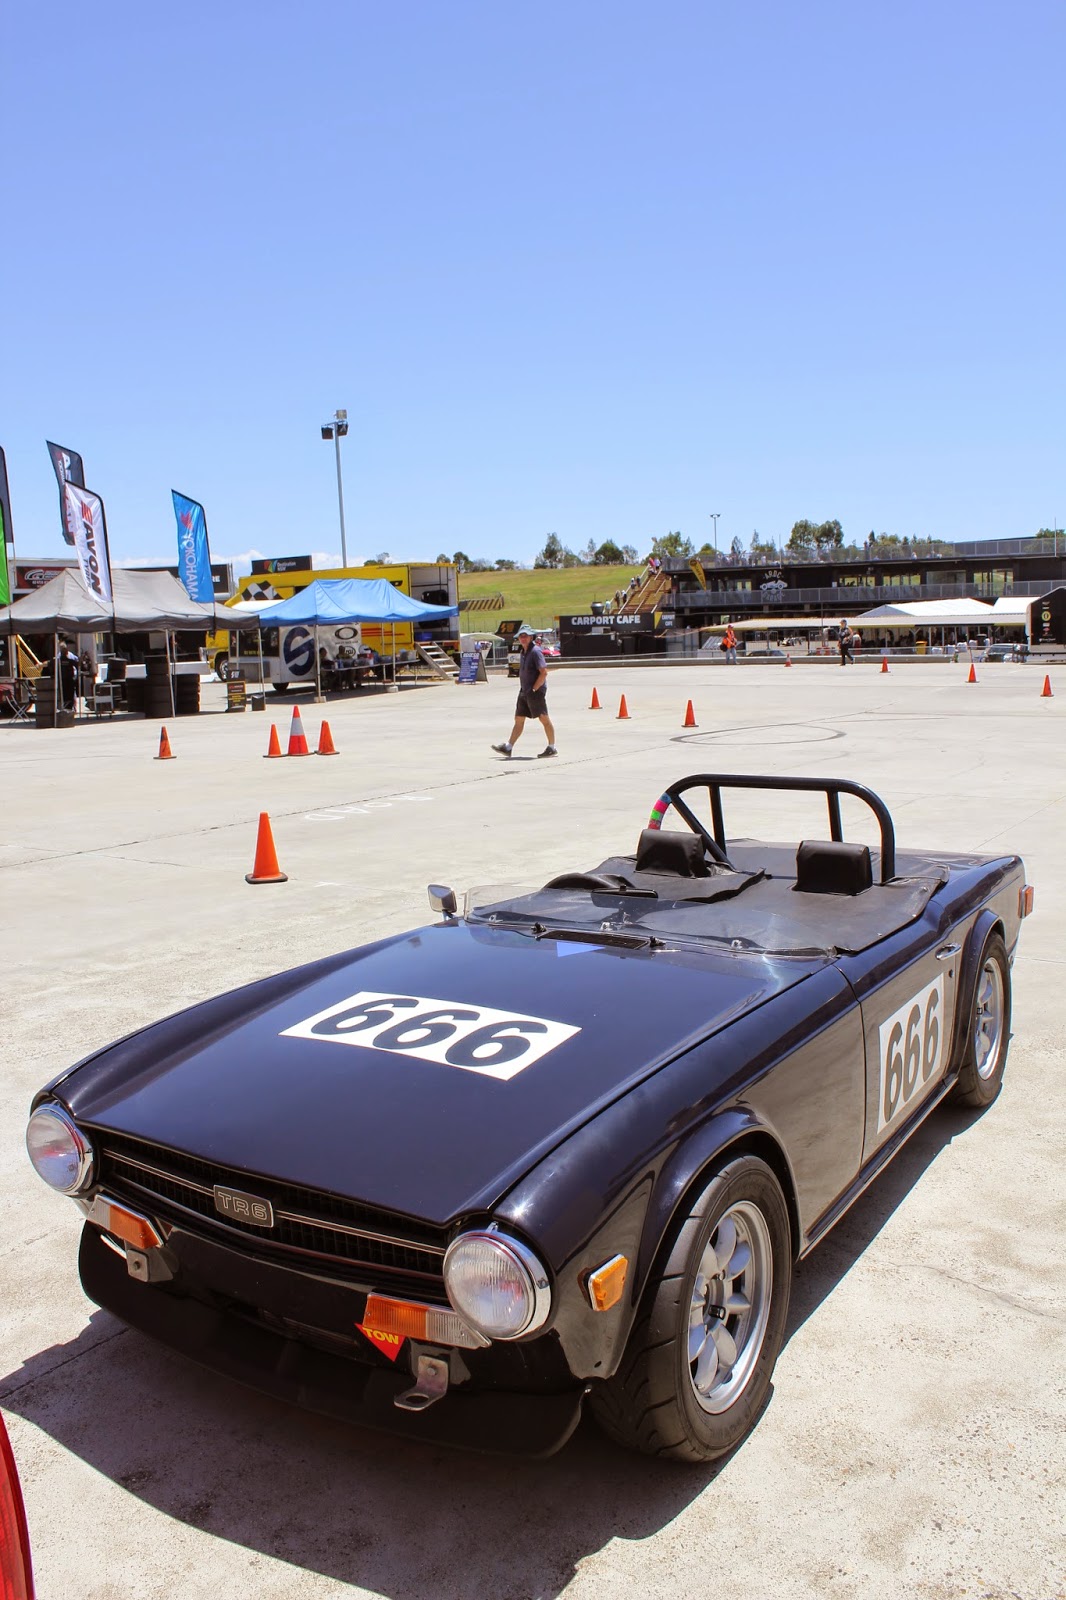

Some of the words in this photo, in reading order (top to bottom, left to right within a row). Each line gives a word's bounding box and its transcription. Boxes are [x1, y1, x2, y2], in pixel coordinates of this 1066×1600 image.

[84, 520, 102, 595] AVON
[184, 533, 199, 600] YOKOHAMA
[571, 616, 615, 626] CARPORT
[616, 615, 641, 625] CAFE
[310, 998, 548, 1067] 666
[883, 988, 939, 1123] 666
[218, 1191, 267, 1220] TR6
[362, 1327, 399, 1345] TOW
